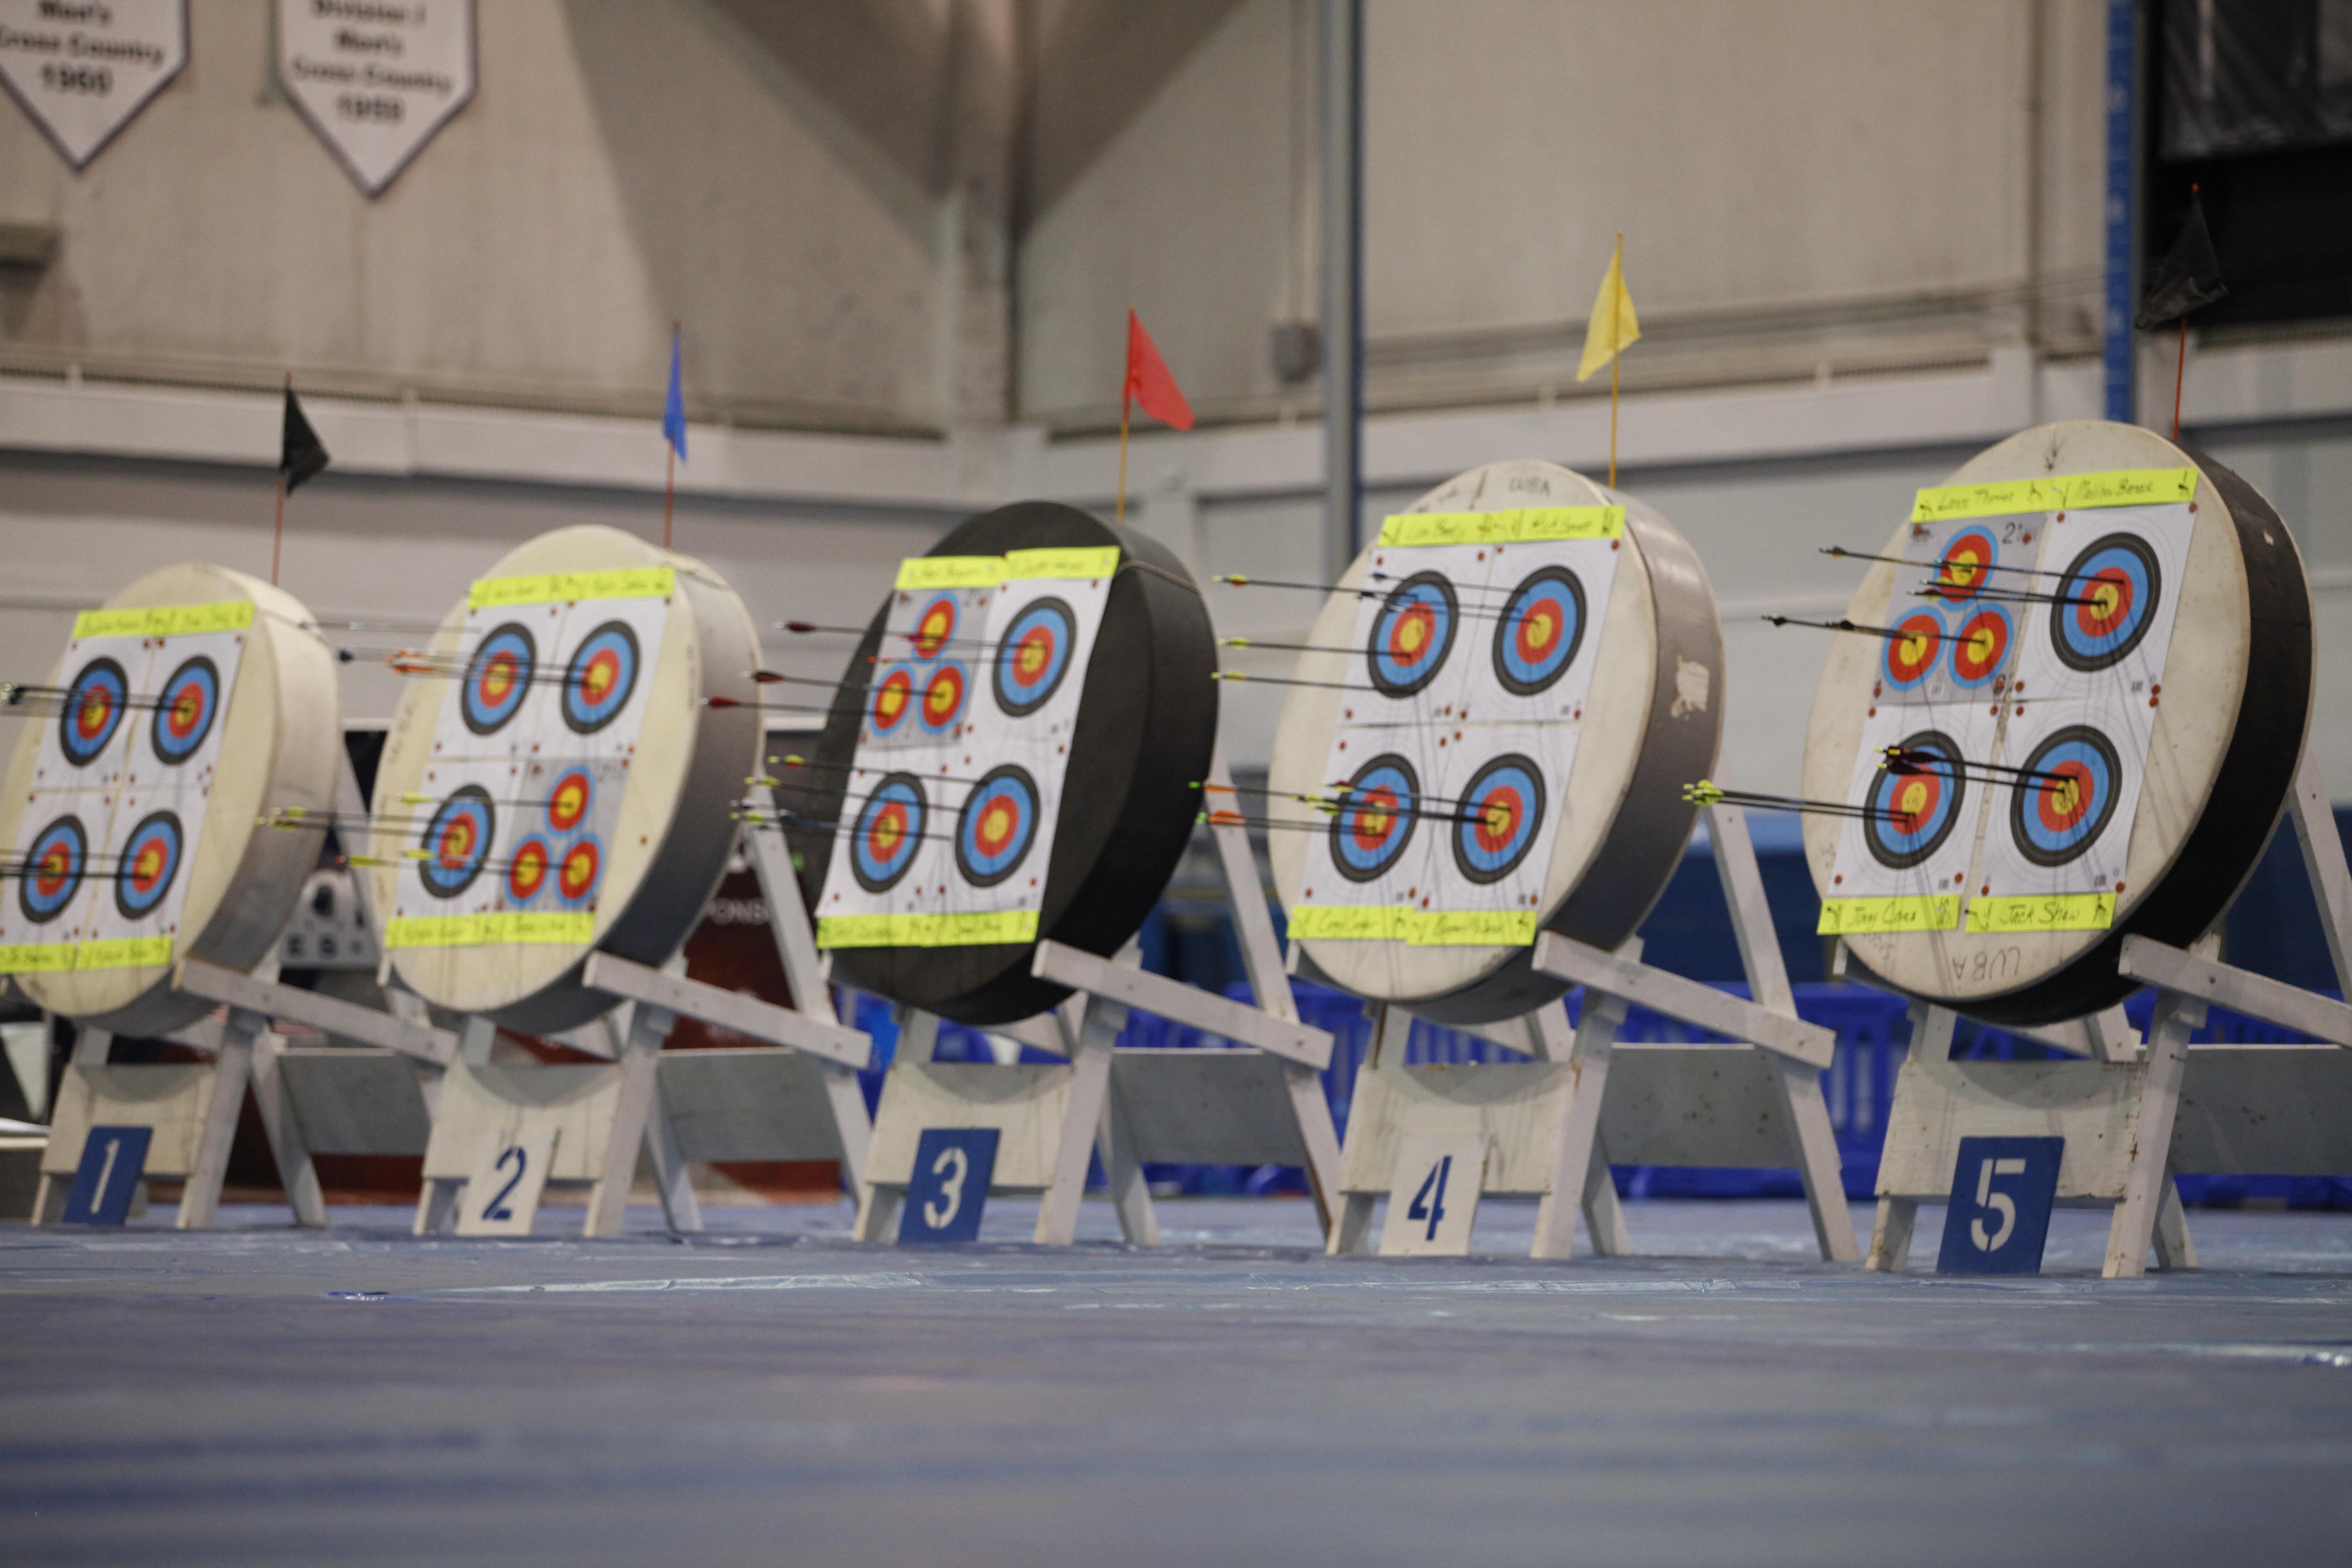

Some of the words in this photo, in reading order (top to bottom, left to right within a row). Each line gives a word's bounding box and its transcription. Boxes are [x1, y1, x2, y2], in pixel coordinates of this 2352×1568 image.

[90, 1137, 120, 1215] 1
[481, 1145, 527, 1221] 2
[923, 1146, 968, 1230] 3
[1407, 1155, 1452, 1242] 4
[1971, 1158, 2026, 1252] 5
